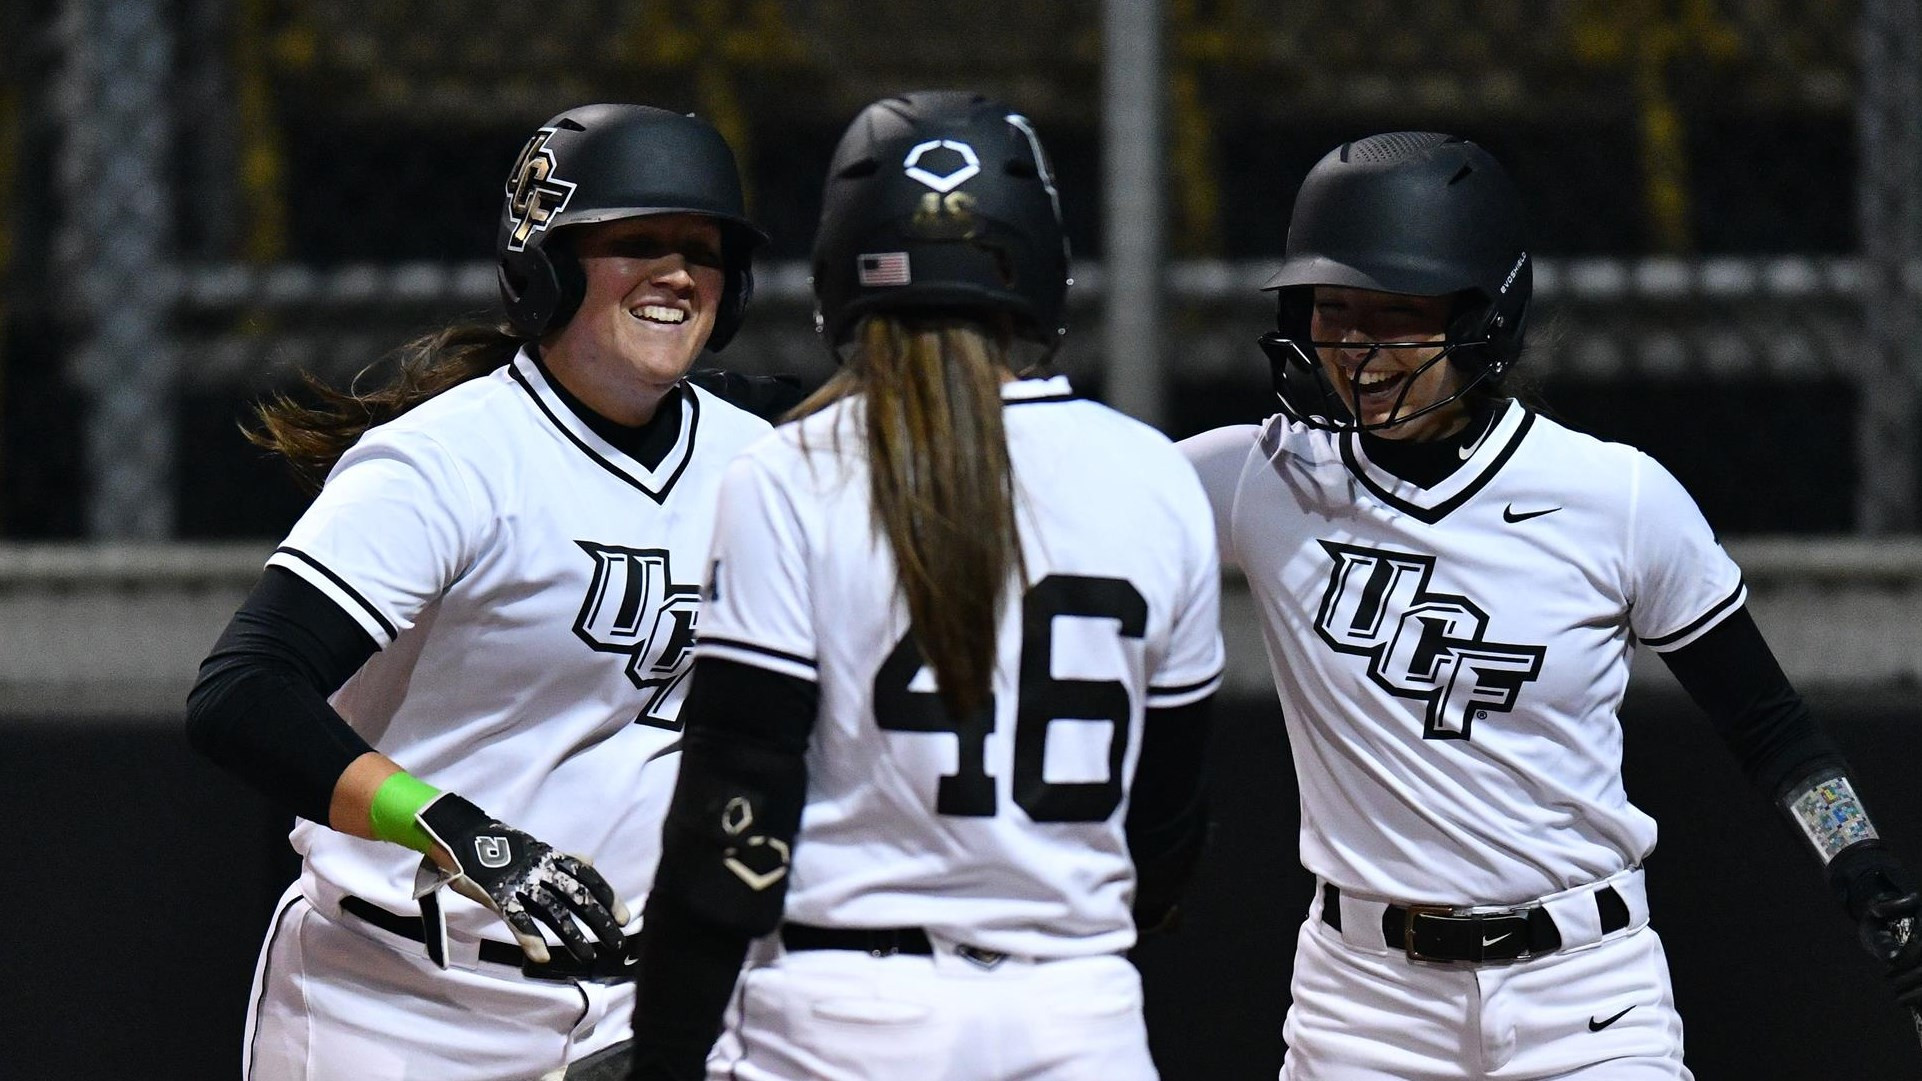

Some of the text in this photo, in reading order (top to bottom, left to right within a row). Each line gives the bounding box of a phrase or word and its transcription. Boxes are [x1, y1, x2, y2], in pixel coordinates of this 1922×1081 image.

[505, 127, 577, 252] UCF
[1500, 251, 1527, 294] EVOSHIELD
[873, 574, 1148, 822] 46
[1313, 539, 1548, 741] UCF
